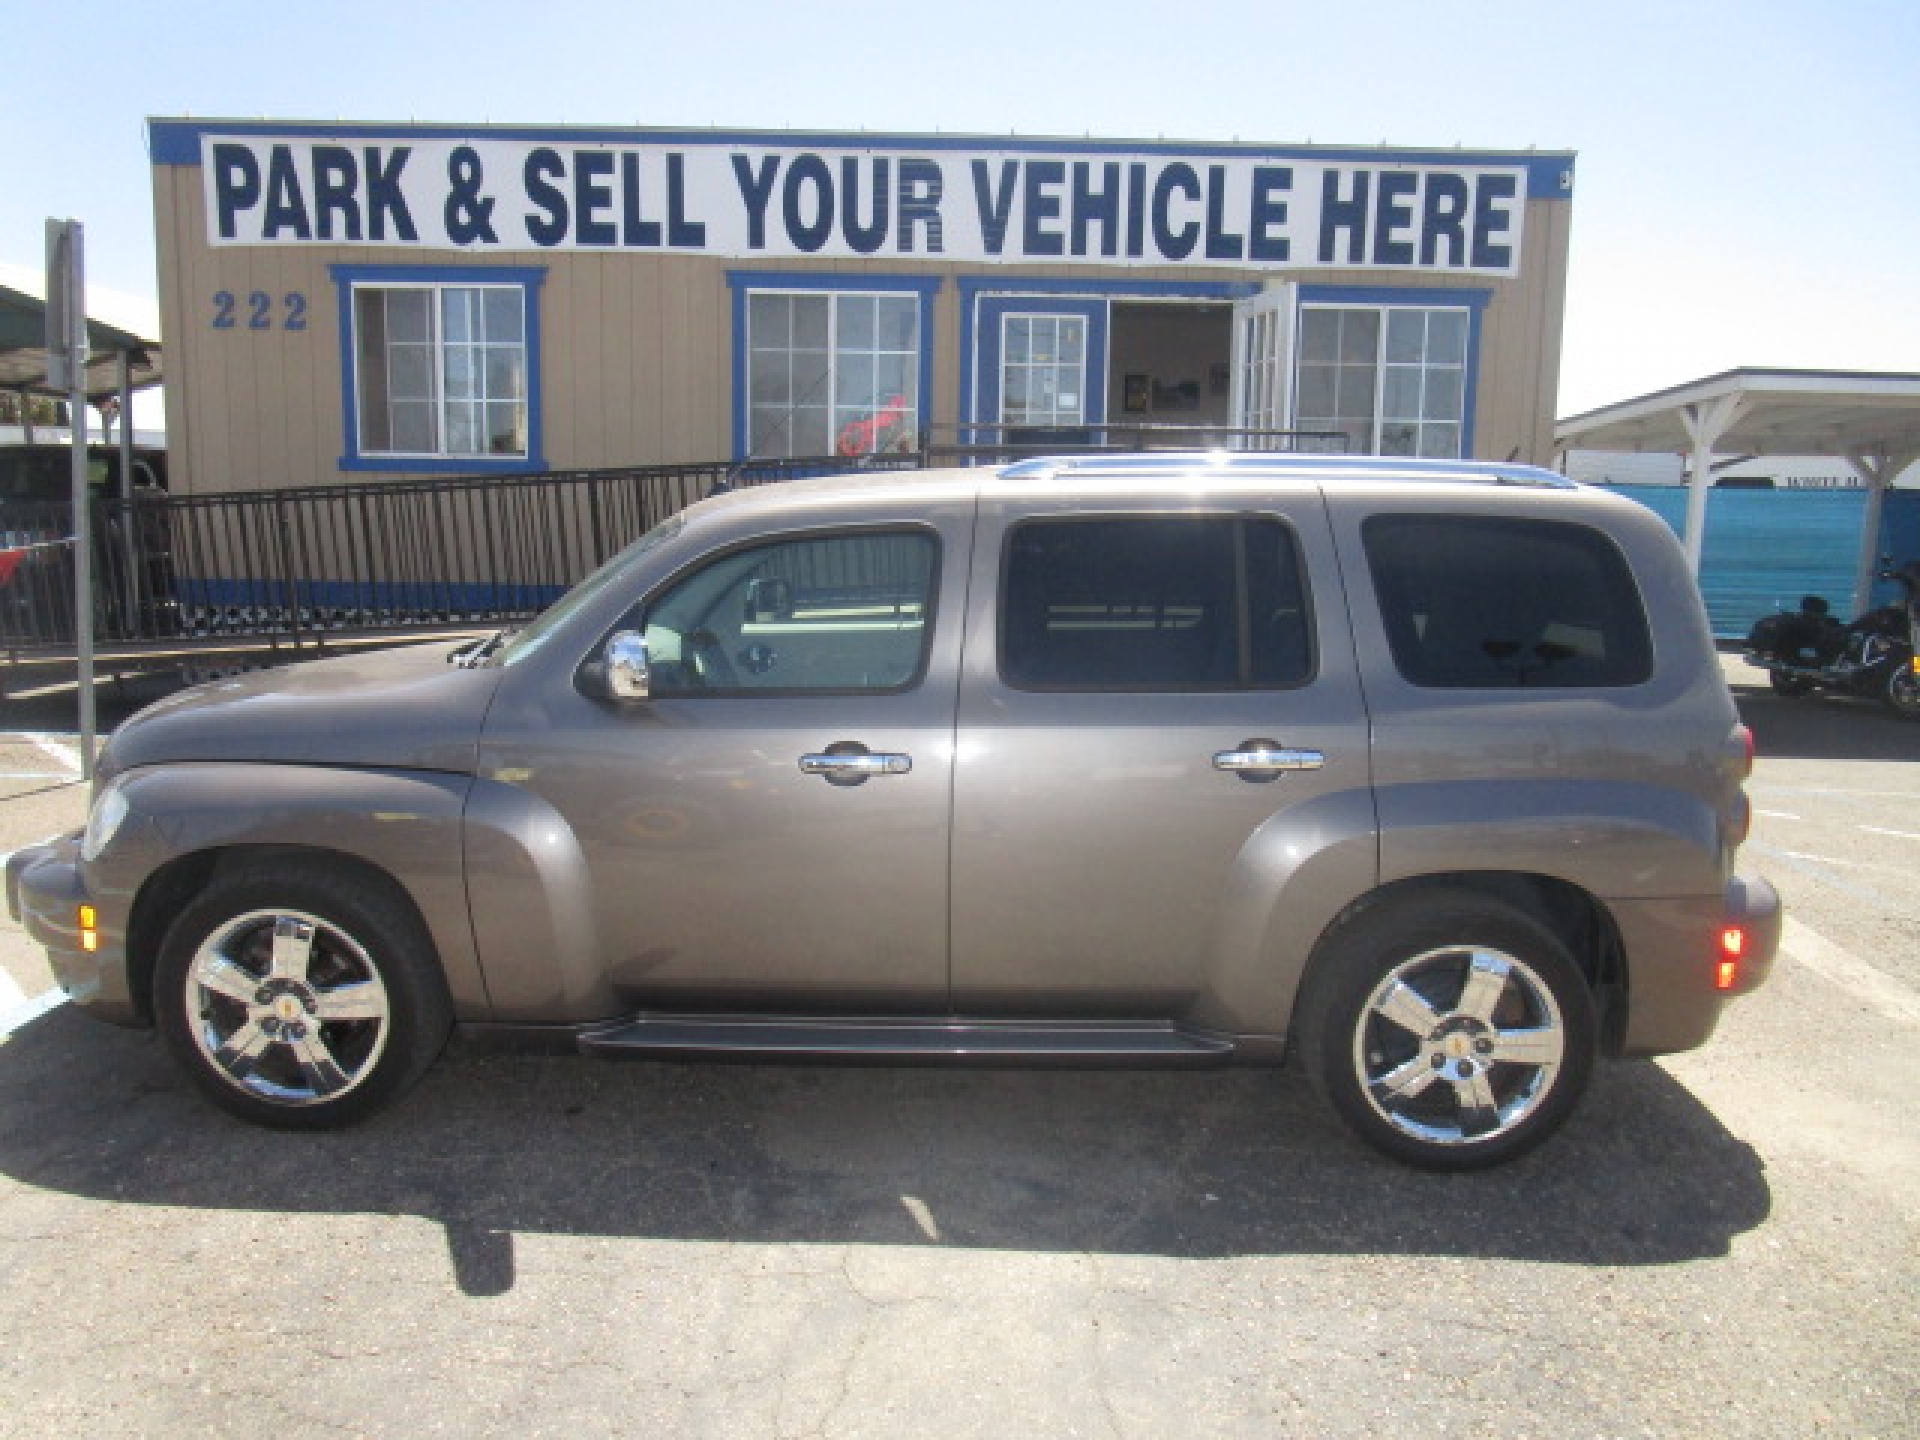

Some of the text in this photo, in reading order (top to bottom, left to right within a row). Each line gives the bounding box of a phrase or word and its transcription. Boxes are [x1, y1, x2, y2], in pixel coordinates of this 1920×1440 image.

[212, 143, 1517, 269] PARK & SELL YOUR VEHICLE HERE
[211, 290, 308, 331] 222
